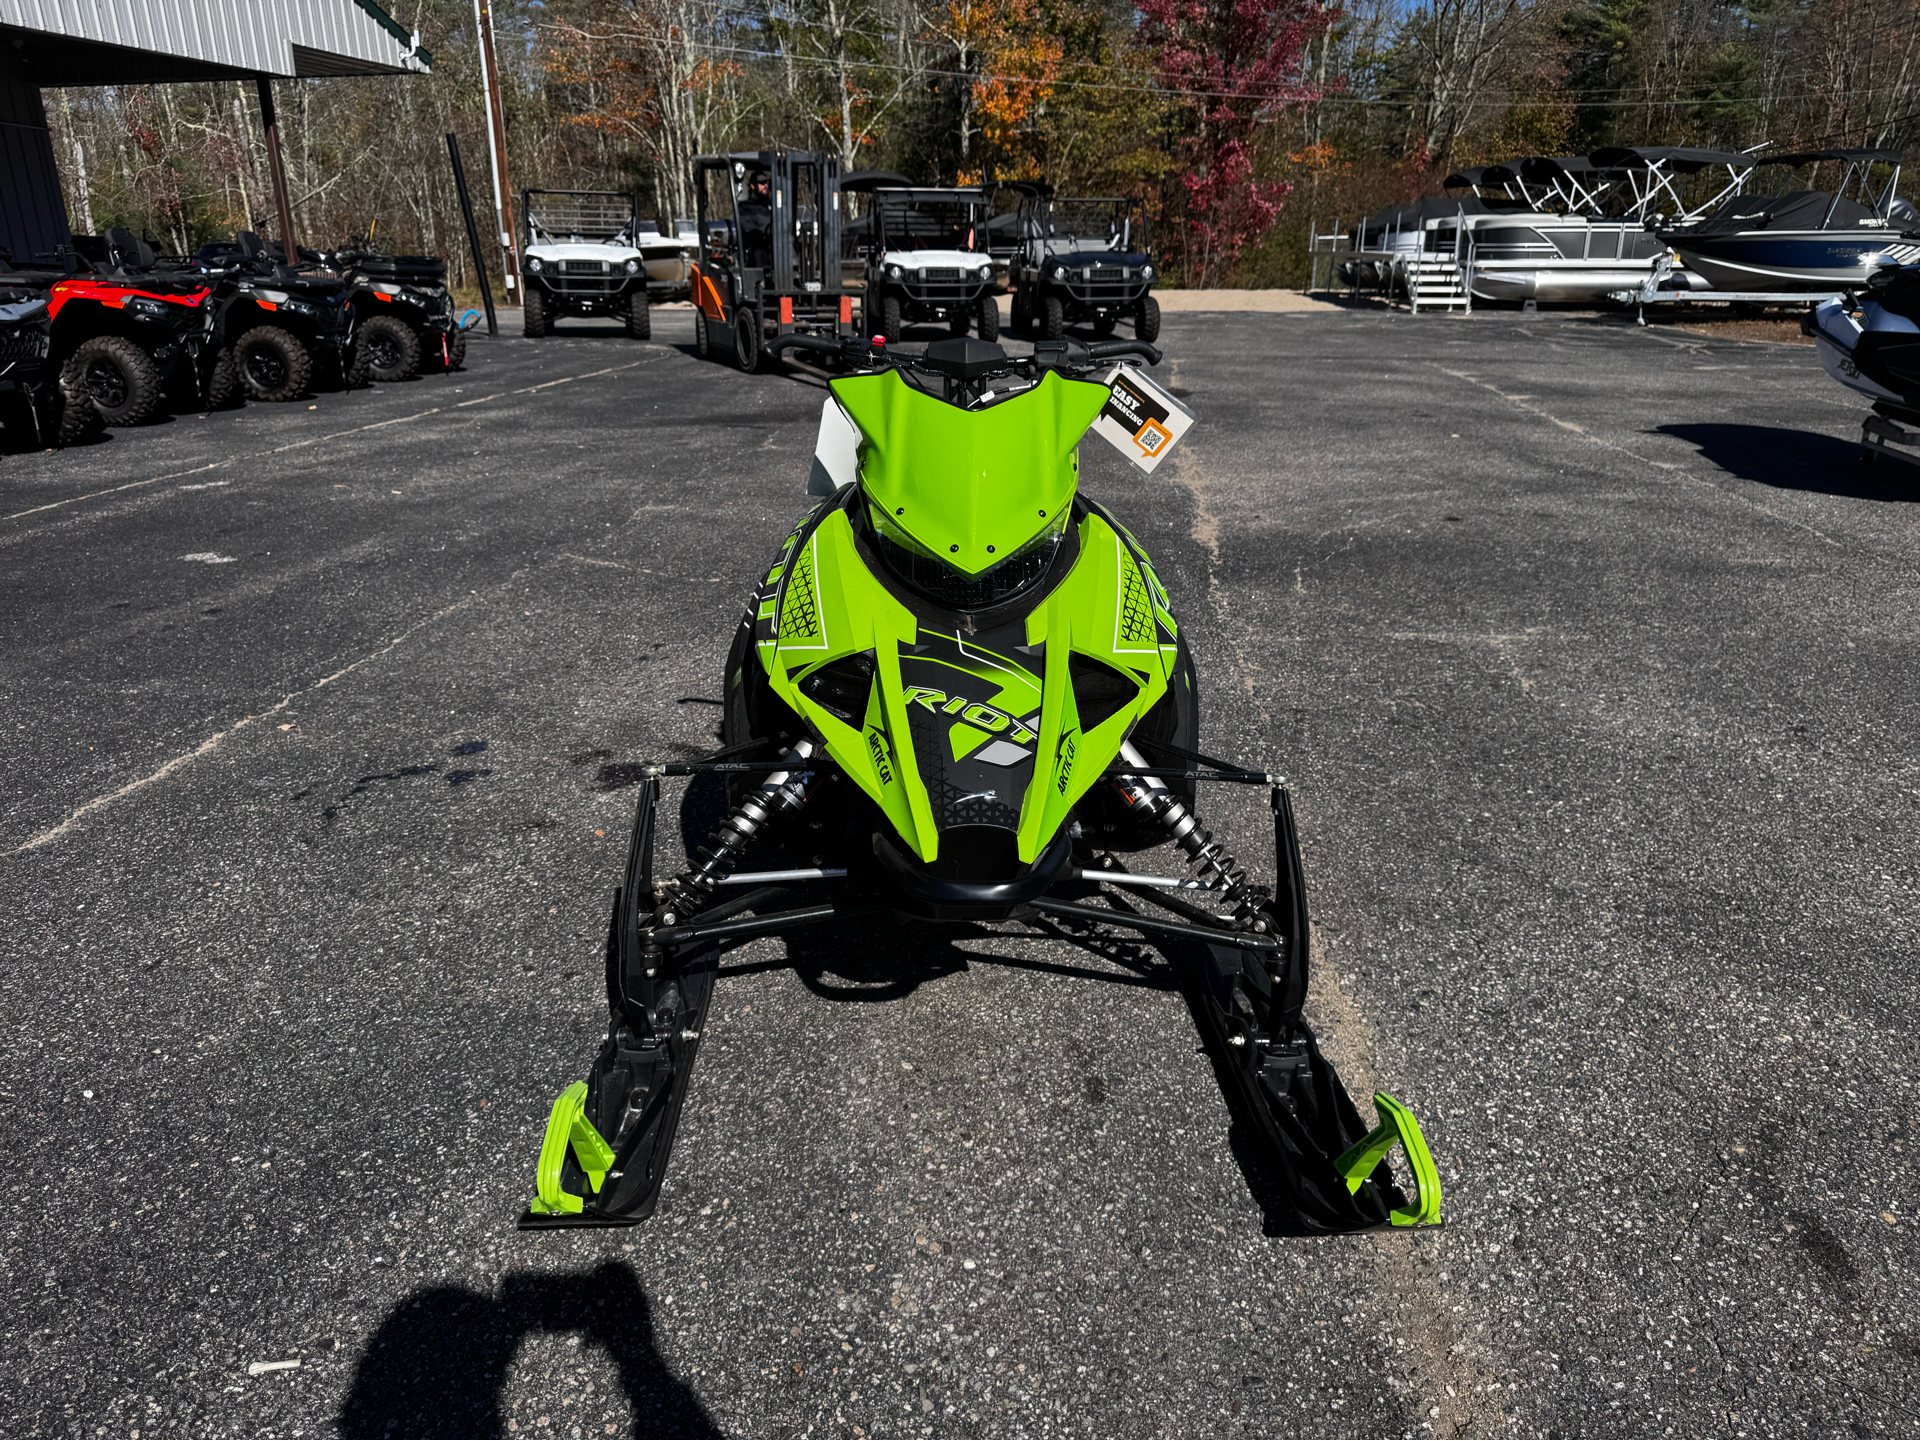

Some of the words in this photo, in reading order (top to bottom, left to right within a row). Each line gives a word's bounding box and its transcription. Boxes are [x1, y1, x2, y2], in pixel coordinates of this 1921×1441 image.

[1109, 395, 1144, 426] INANCING
[1112, 384, 1140, 411] EASY
[903, 686, 1038, 745] RIOT
[868, 732, 886, 768] ARCTIC
[879, 765, 893, 786] CAT
[1057, 755, 1072, 796] ARCTIC
[1066, 737, 1076, 760] CAT
[1184, 770, 1219, 778] ATAC
